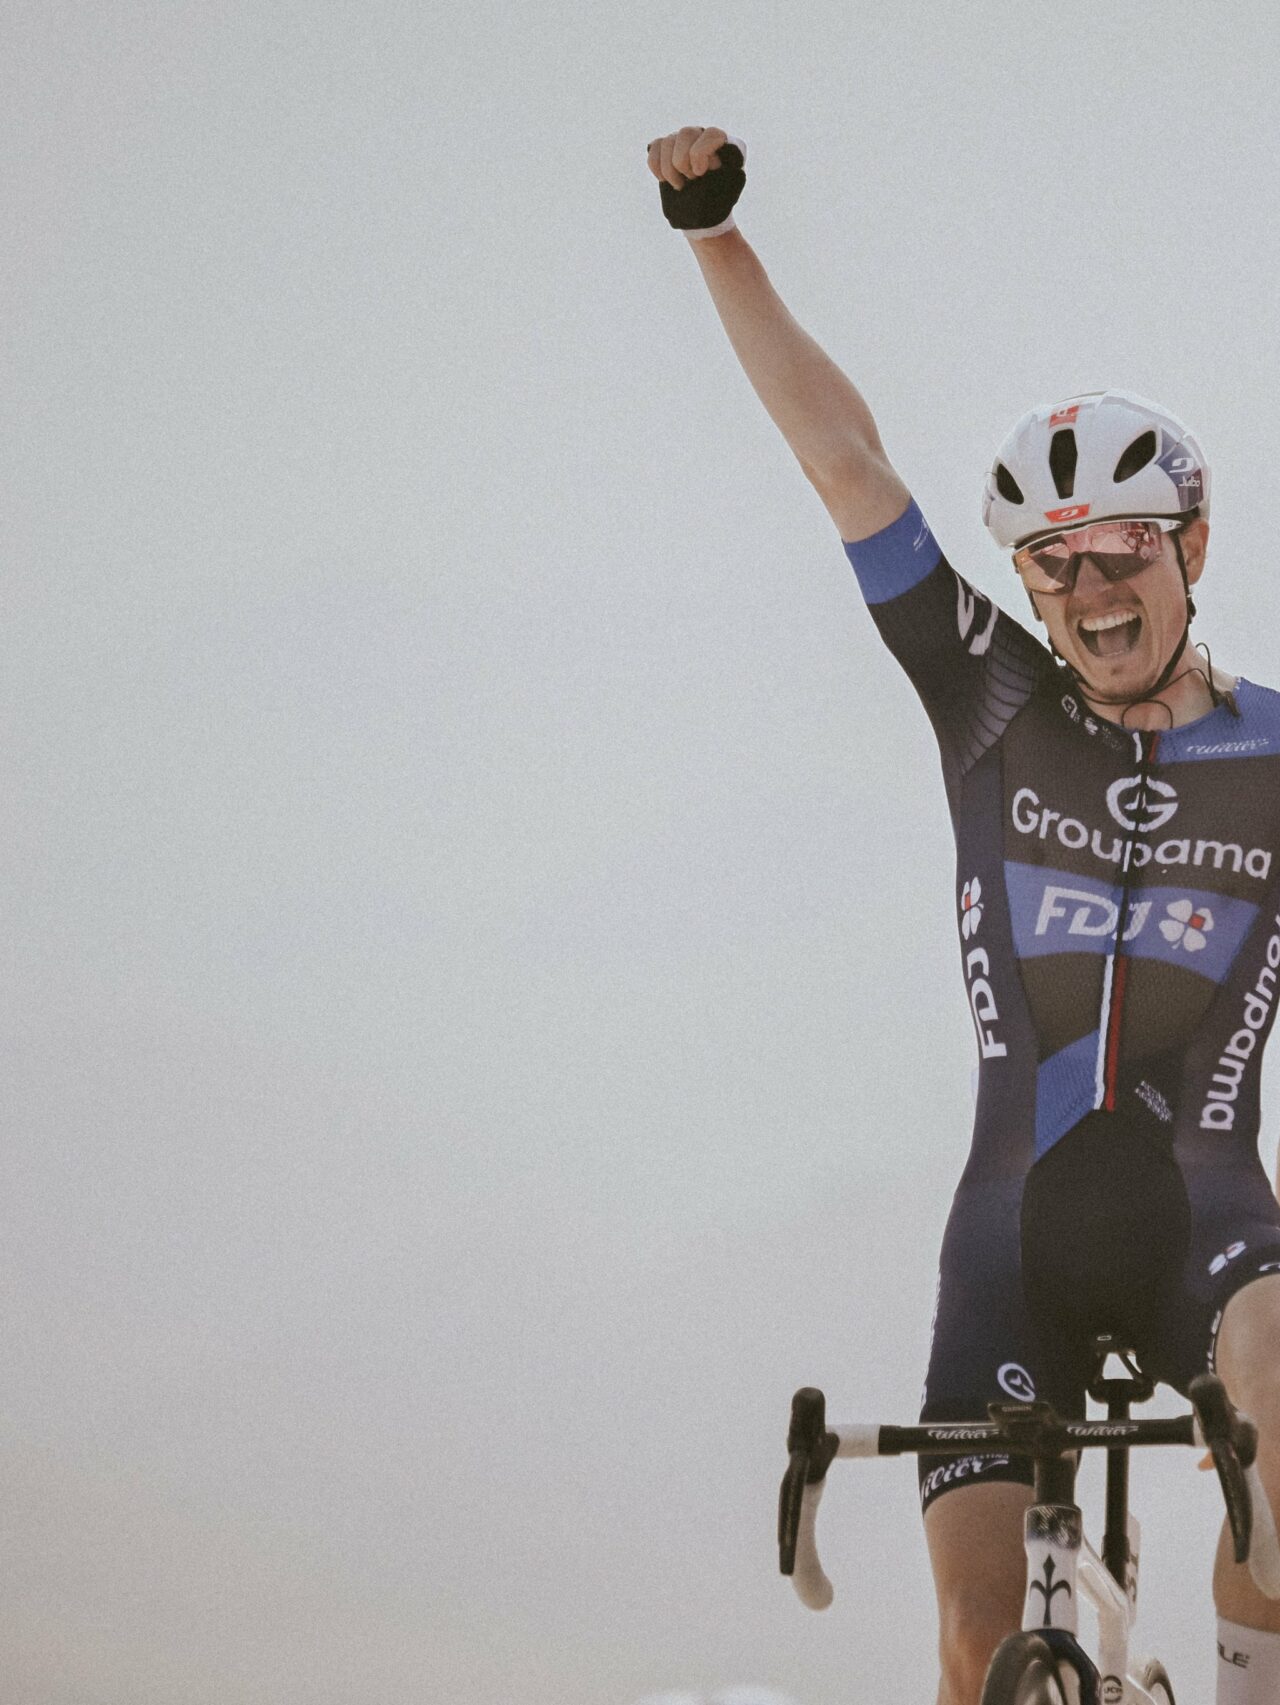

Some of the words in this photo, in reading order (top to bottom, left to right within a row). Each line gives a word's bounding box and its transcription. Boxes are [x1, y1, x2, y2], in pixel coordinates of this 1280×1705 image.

[1012, 788, 1272, 879] Groupama
[1035, 886, 1152, 941] FDJ
[967, 947, 1008, 1058] FDJ
[921, 1459, 1009, 1501] ilier
